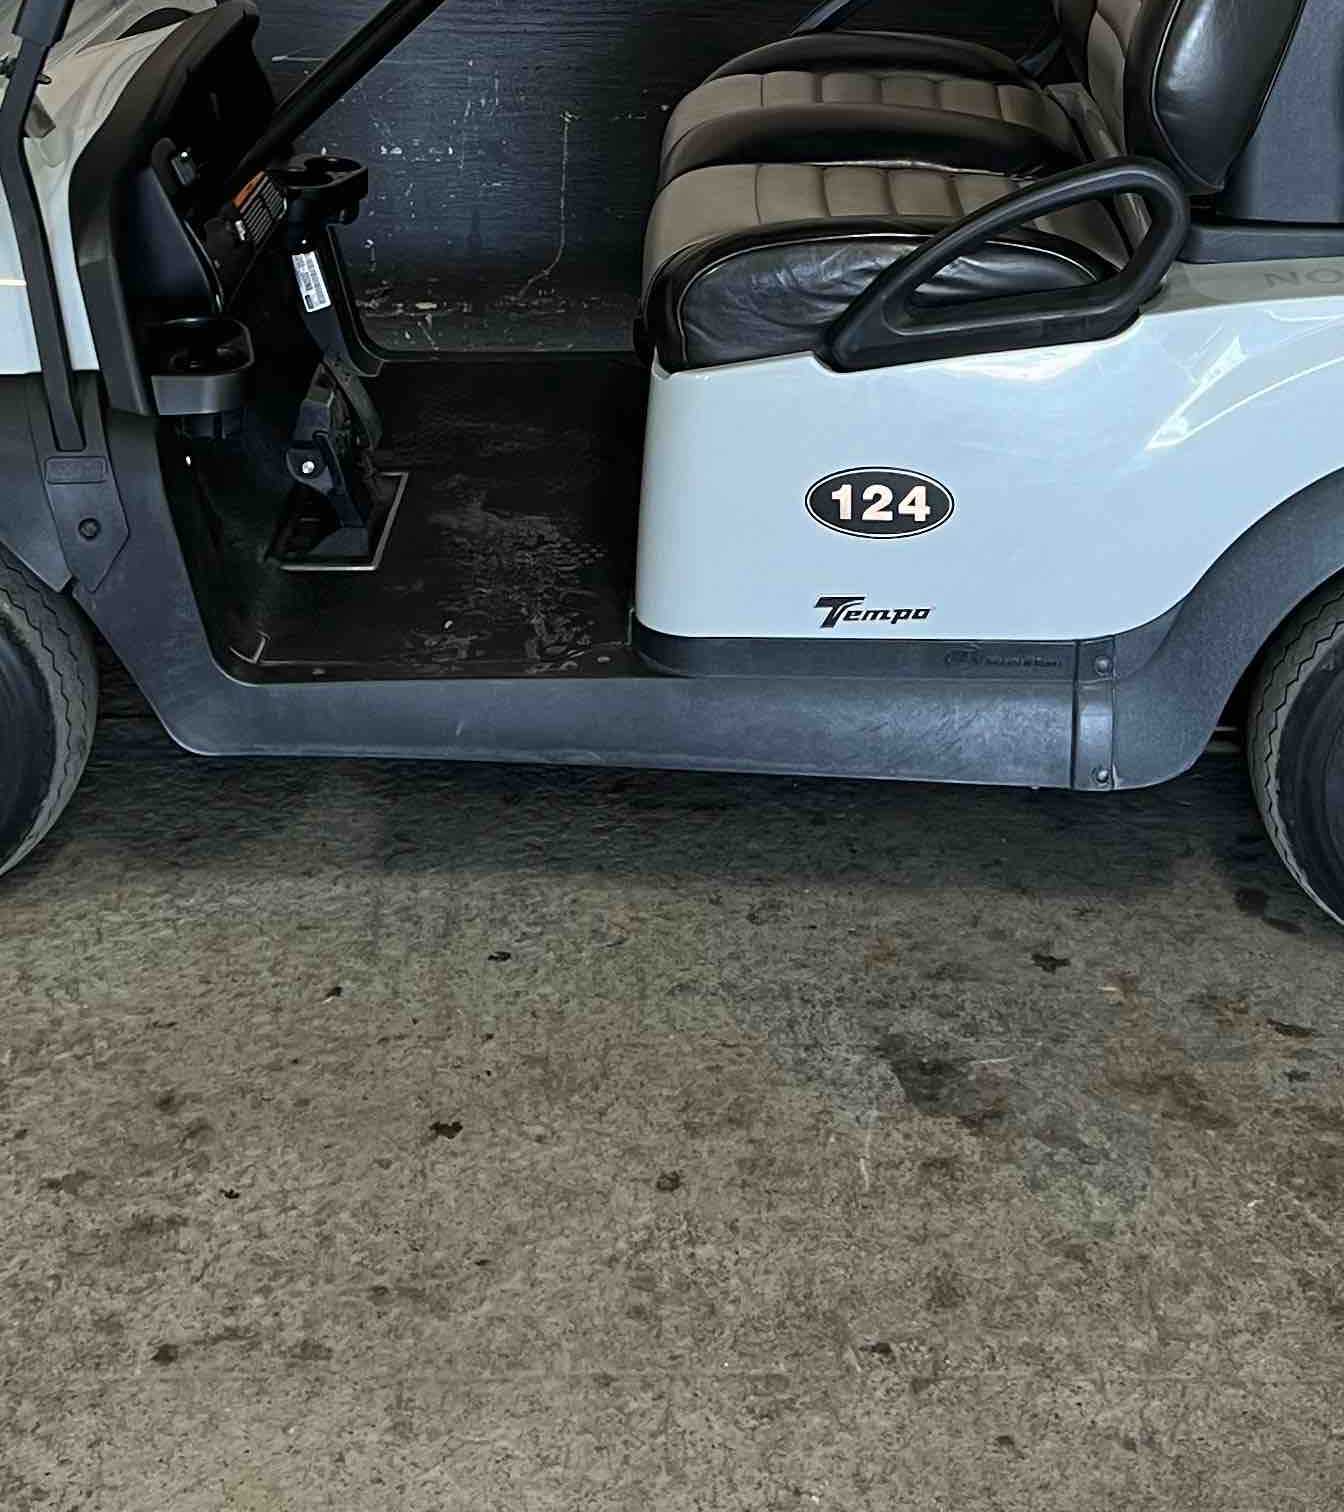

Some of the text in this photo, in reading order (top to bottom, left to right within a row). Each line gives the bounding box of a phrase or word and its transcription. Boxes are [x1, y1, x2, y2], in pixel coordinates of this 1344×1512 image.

[1263, 266, 1344, 288] NO
[831, 484, 931, 522] 124
[814, 596, 932, 629] Tempo
